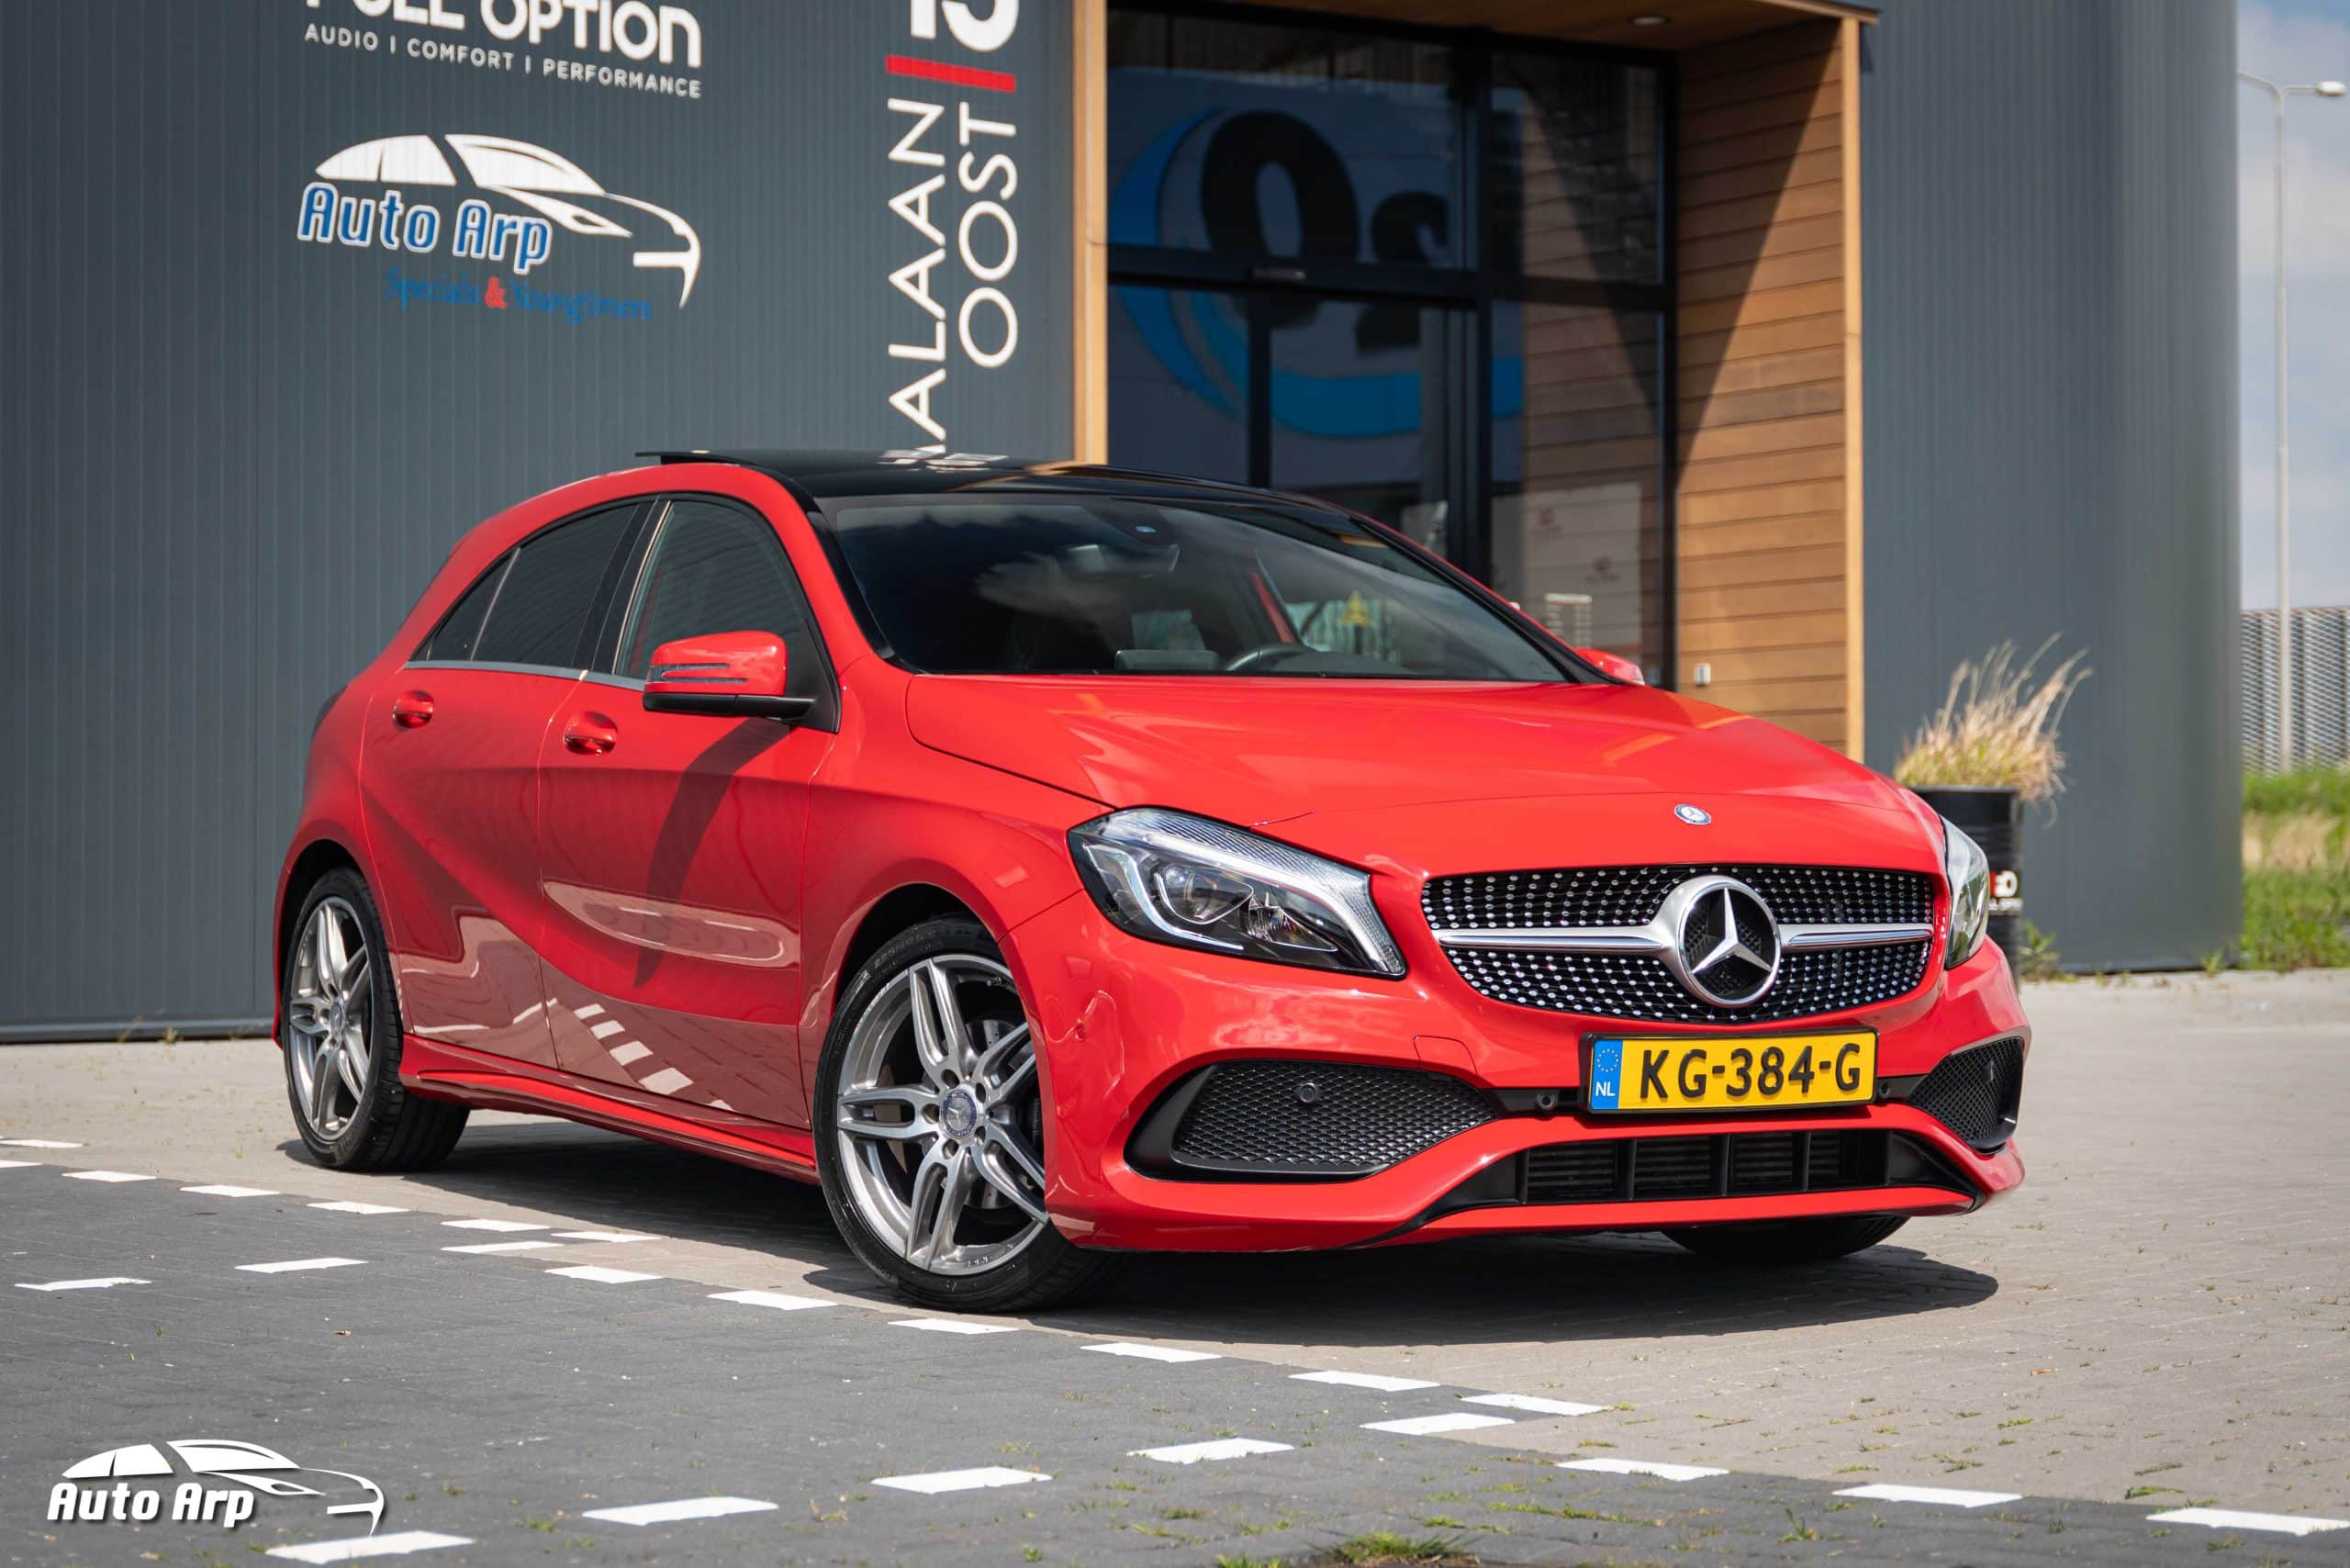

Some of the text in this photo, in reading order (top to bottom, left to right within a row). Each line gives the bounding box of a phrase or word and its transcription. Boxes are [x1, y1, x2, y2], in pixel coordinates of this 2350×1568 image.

[304, 23, 378, 51] AUDIO
[407, 38, 514, 71] COMFORT
[543, 58, 701, 99] PERFORMANCE
[297, 182, 552, 274] Auto Arp
[958, 101, 1018, 368] OOST
[386, 266, 480, 312] Specials
[484, 276, 508, 309] &
[887, 97, 946, 454] ALAAN
[1595, 1081, 1616, 1097] NL
[1640, 1043, 1861, 1099] KG-384-G
